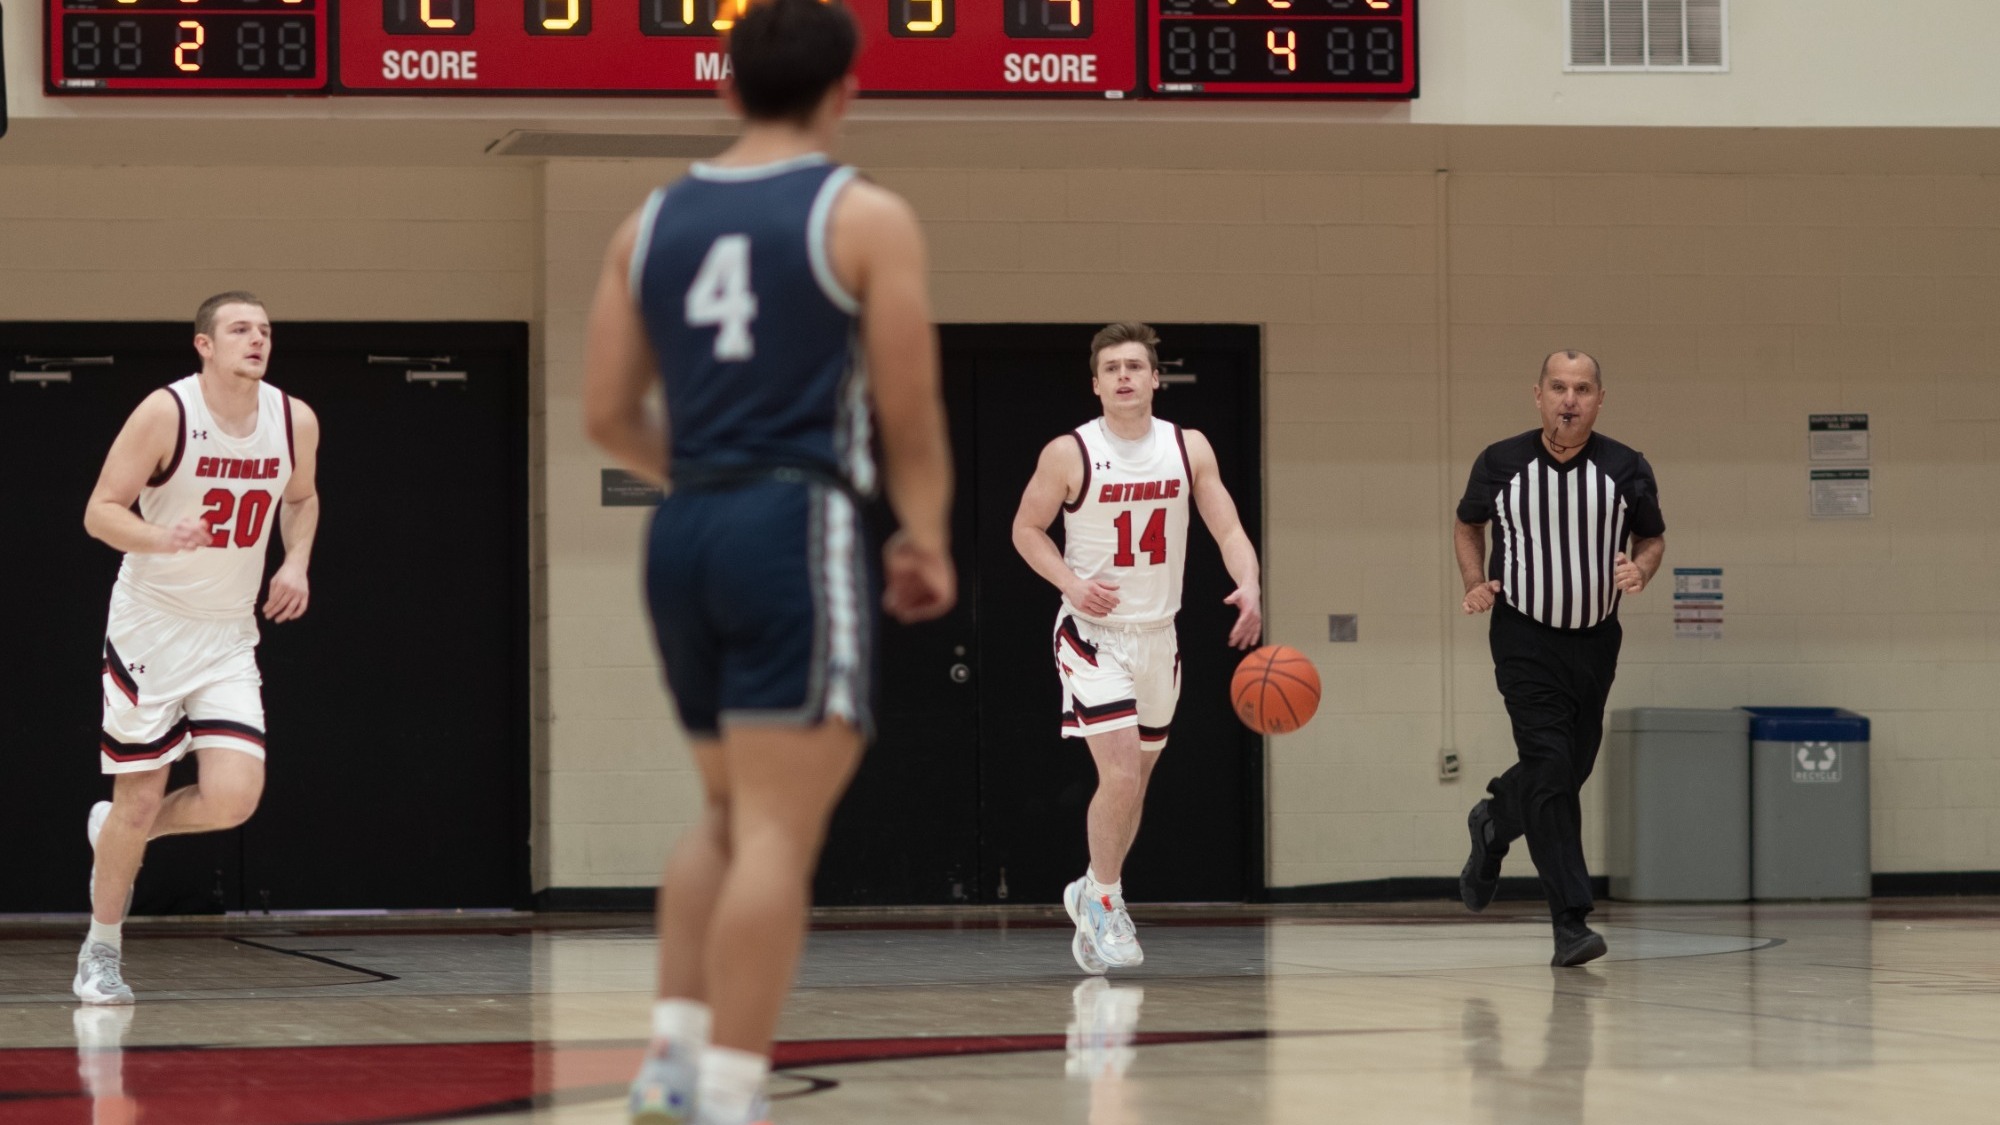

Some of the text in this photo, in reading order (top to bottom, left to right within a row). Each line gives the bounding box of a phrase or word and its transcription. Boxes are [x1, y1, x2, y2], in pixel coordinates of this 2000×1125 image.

[174, 21, 204, 71] 2
[1267, 30, 1296, 72] 4
[382, 50, 478, 80] SCORE
[695, 52, 736, 81] MA
[1003, 53, 1097, 83] SCORE
[684, 233, 759, 362] 4
[195, 456, 280, 479] CATHOLIC
[1098, 479, 1181, 503] CATHOLIC
[200, 488, 272, 549] 20
[1113, 508, 1167, 567] 14
[1796, 771, 1838, 780] RECYCLE
